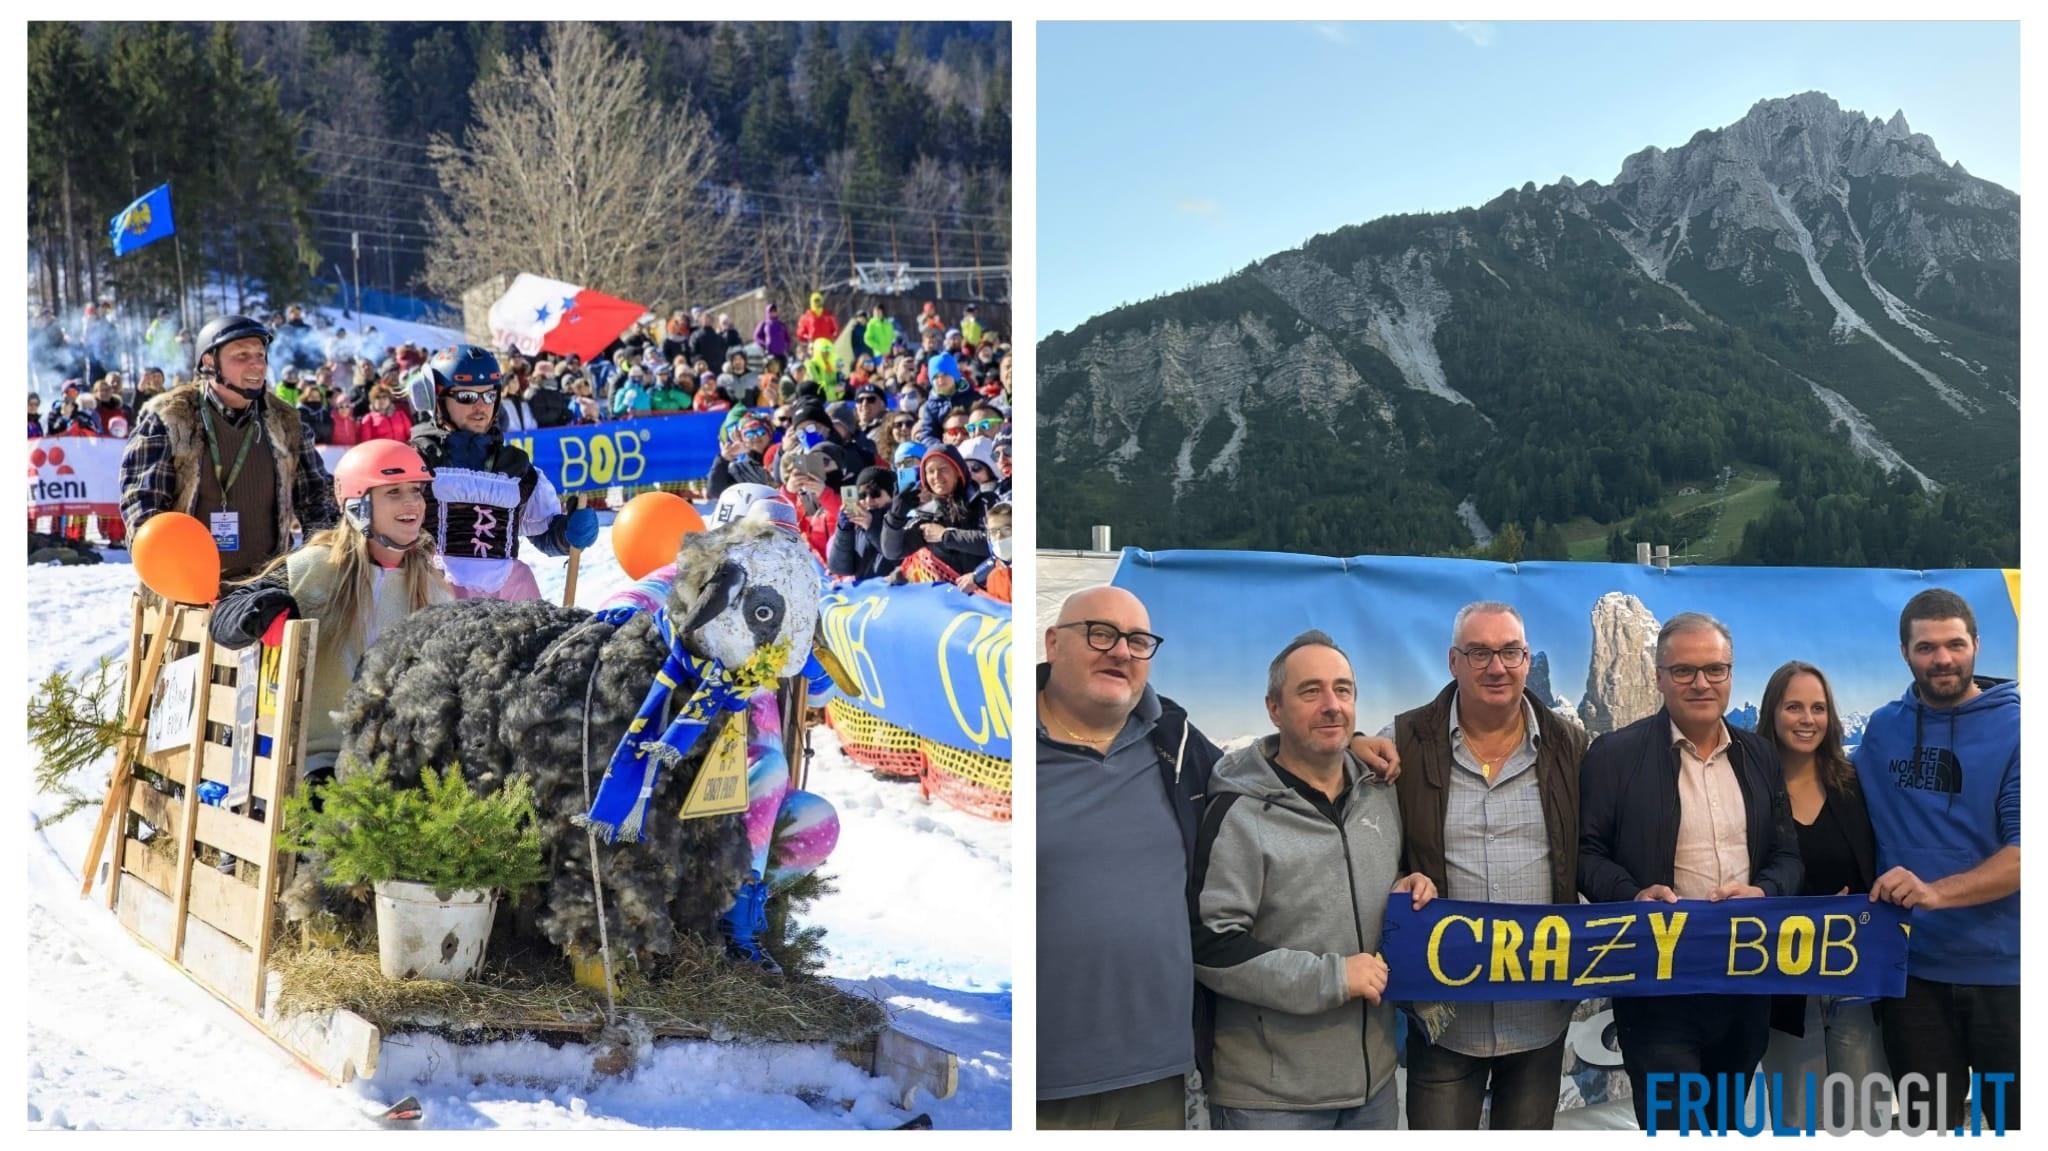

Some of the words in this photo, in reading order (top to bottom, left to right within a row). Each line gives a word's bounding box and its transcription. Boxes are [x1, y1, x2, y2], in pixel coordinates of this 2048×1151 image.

[27, 479, 87, 501] rteni
[938, 610, 1012, 745] CR
[1898, 774, 1934, 790] FACE
[1426, 911, 1689, 987] CRAZY
